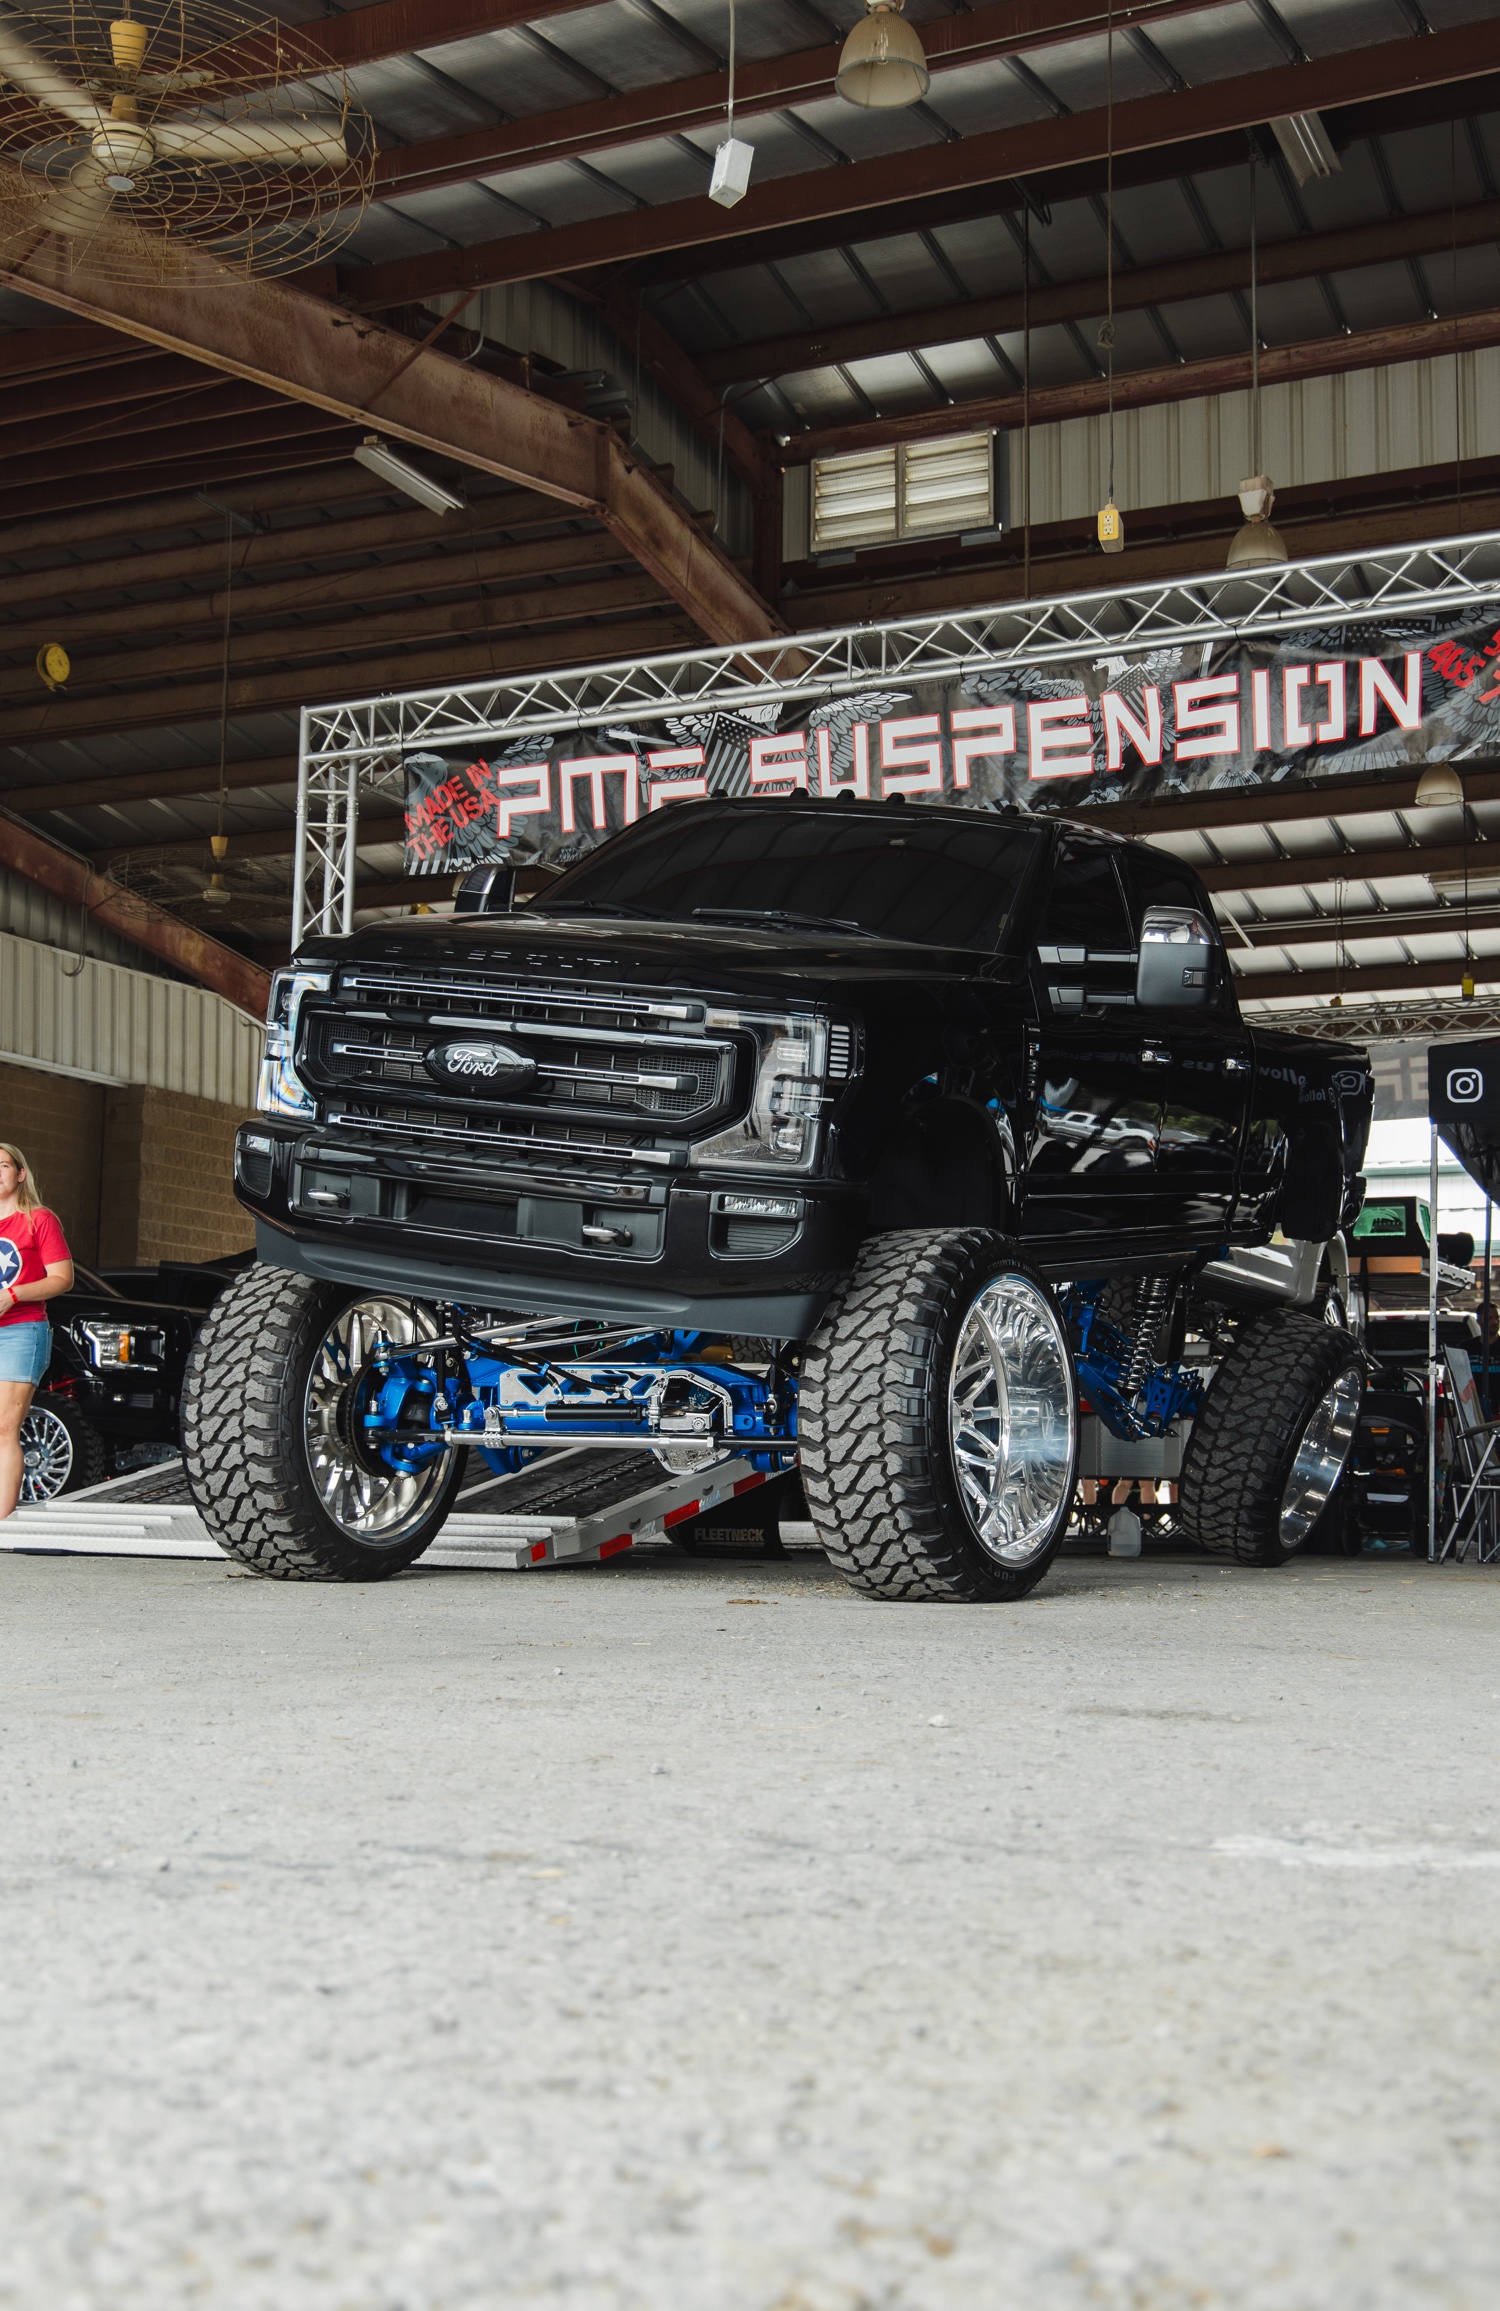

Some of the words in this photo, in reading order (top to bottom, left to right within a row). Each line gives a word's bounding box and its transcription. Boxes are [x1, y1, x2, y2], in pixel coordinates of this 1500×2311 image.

[1427, 640, 1487, 689] 465
[749, 650, 1422, 798] SUSPENSION
[404, 775, 469, 834] MADE
[465, 758, 493, 789] IN
[407, 817, 454, 860] THE
[449, 787, 500, 829] USA
[447, 1048, 500, 1077] Ford
[694, 1527, 765, 1542] FLEETNECK
[986, 1563, 1016, 1582] FURY
